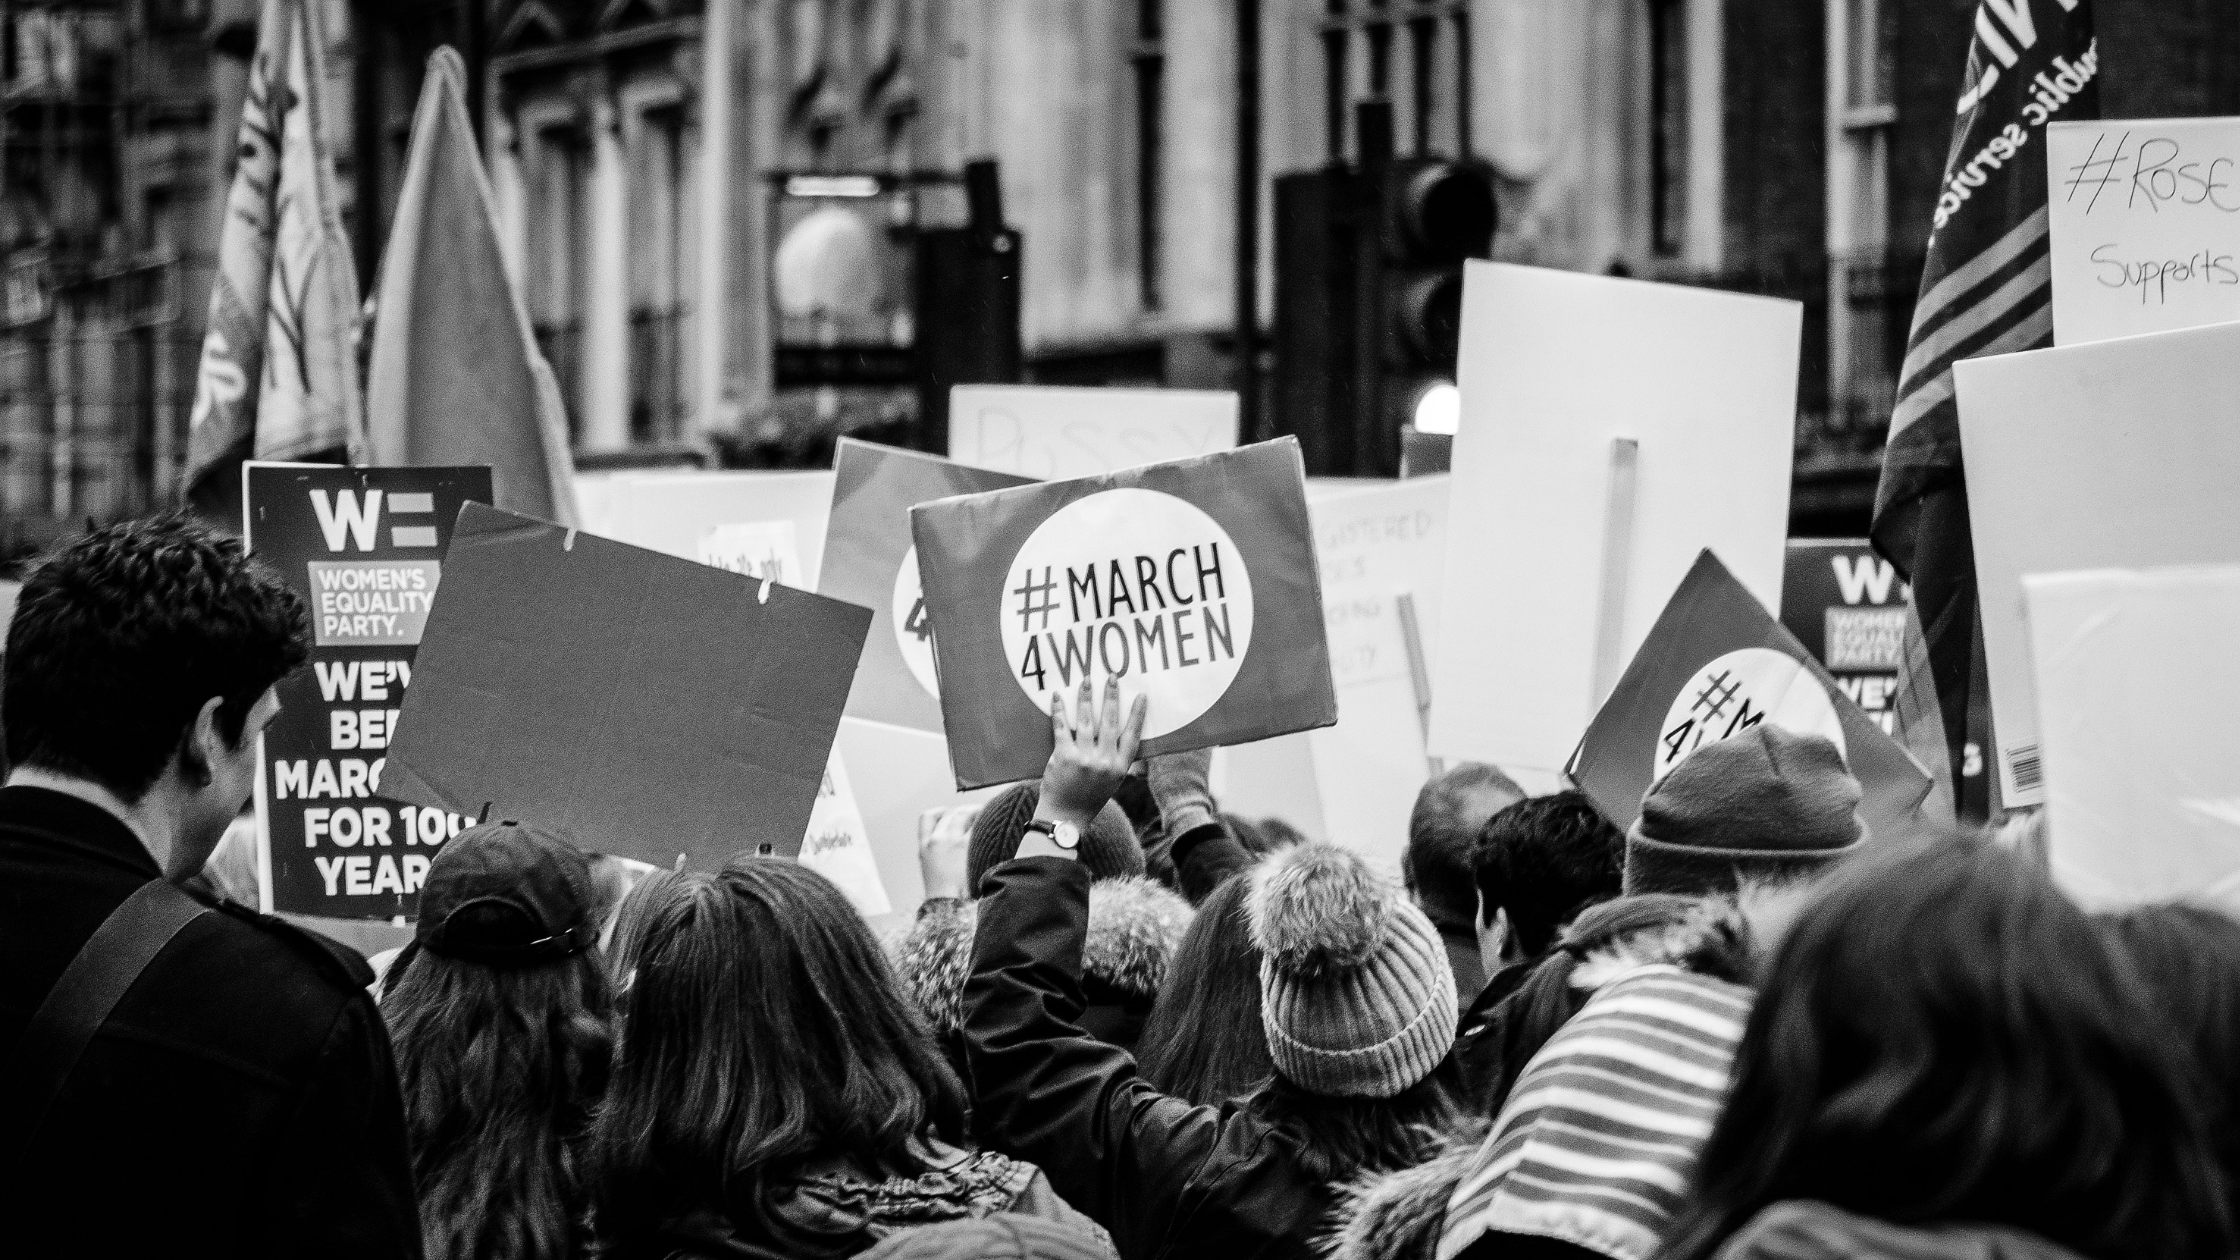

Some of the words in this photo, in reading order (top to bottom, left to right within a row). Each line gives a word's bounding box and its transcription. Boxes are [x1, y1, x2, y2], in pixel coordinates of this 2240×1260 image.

[318, 568, 427, 592] WOMEN'S
[1013, 541, 1226, 632] #MARCH
[321, 591, 433, 616] EQUALITY
[324, 615, 404, 638] PARTY.
[1020, 603, 1235, 690] 4WOMEN
[304, 806, 392, 848] FOR
[315, 854, 433, 896] YEAR
